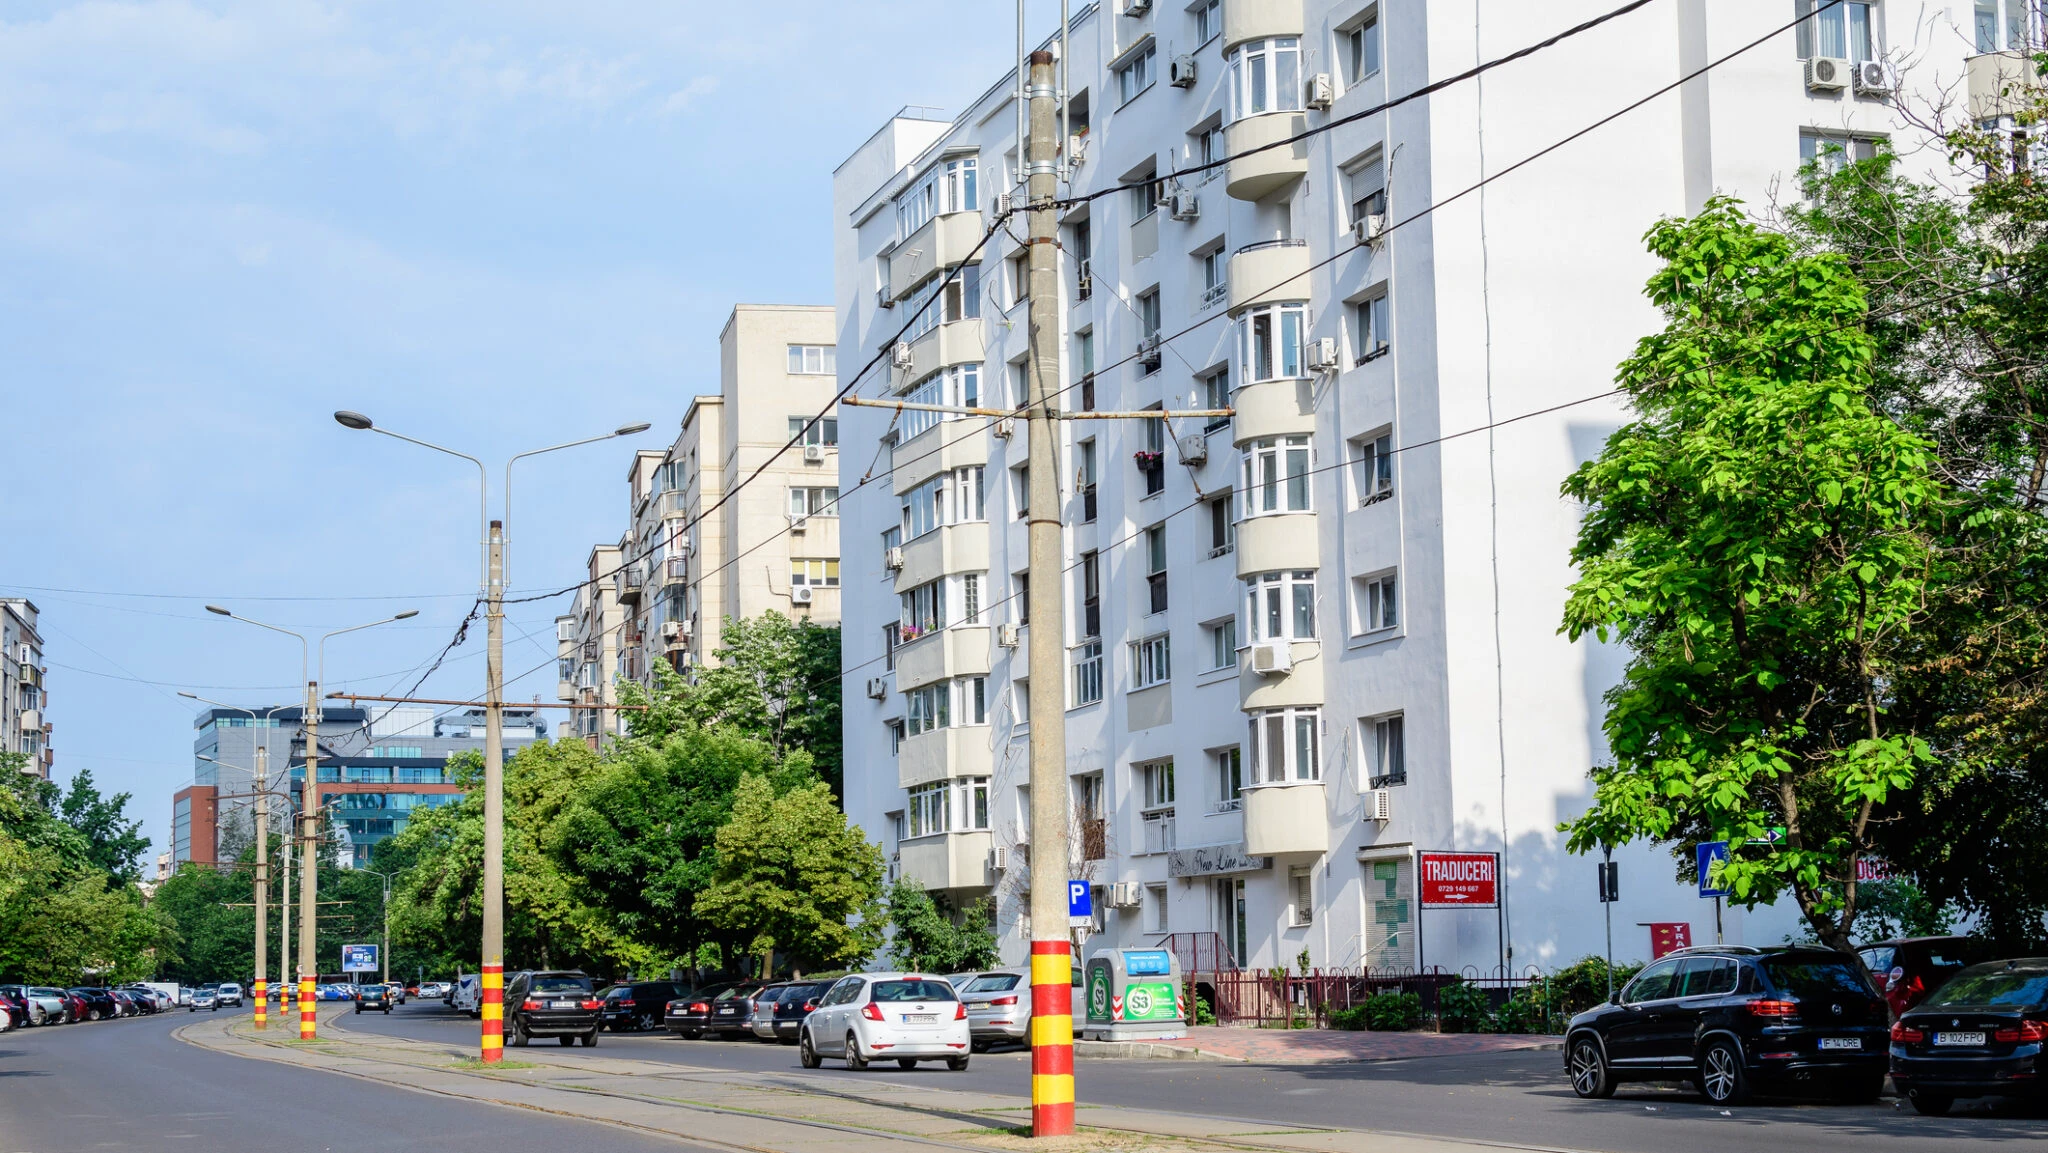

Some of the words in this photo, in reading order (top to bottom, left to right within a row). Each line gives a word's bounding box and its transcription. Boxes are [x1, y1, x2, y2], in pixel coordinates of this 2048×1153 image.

[1215, 846, 1237, 871] Line
[1425, 860, 1492, 881] TRADUCERI
[1071, 884, 1085, 905] P
[1095, 989, 1104, 1006] S3
[1132, 995, 1149, 1009] S3
[1940, 1033, 1946, 1042] B
